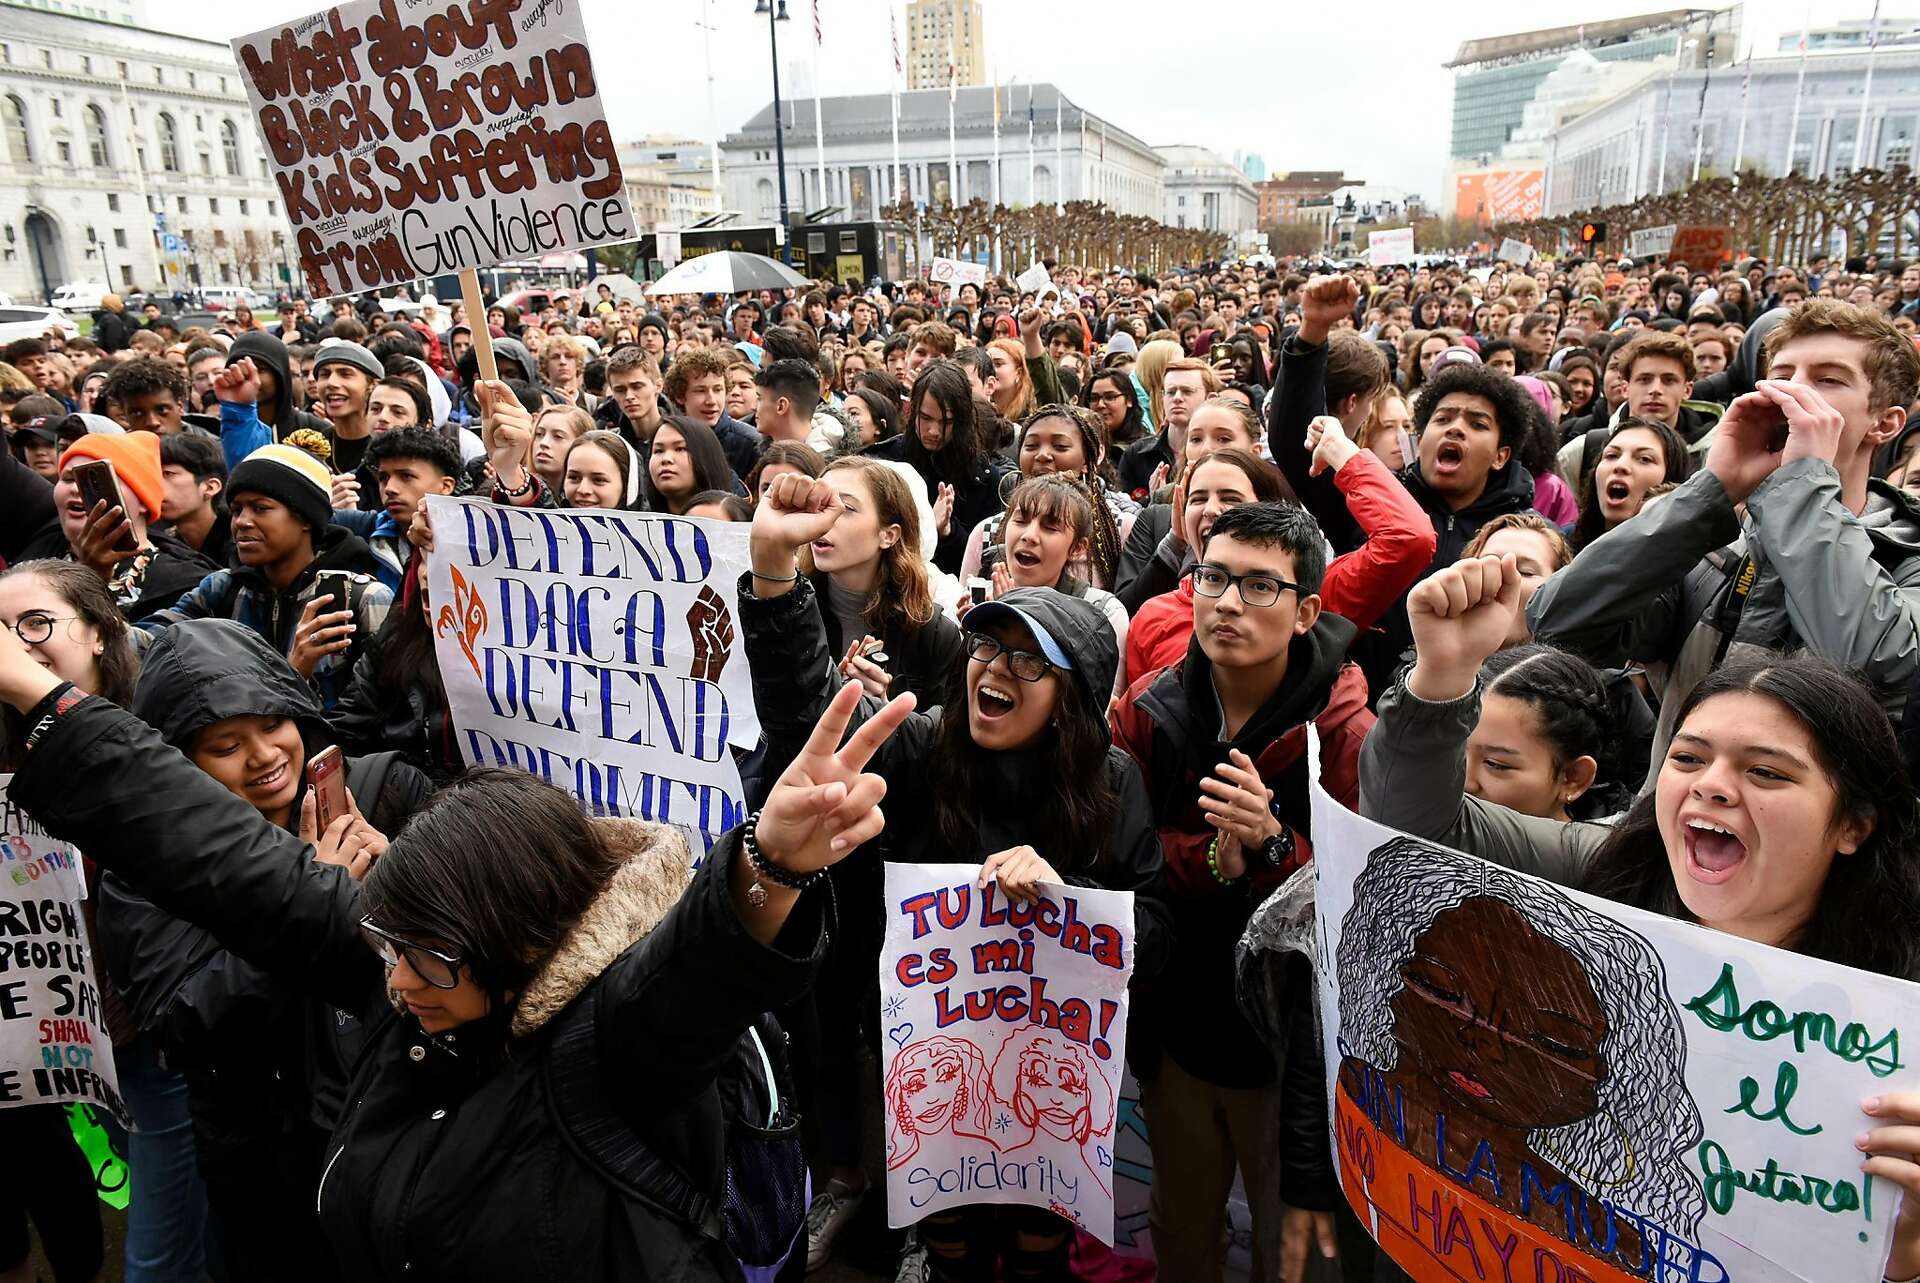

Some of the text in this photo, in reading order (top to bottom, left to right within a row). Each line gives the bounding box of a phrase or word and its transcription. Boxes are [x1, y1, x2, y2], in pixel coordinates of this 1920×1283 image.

[240, 0, 523, 100] What about
[383, 71, 430, 142] &
[402, 208, 481, 277] Gun
[466, 198, 628, 259] Violence
[459, 503, 713, 584] DEFEND
[495, 577, 668, 668] DACA
[482, 647, 730, 764] DEFEND
[464, 728, 749, 870] DAMER
[900, 883, 971, 940] TU
[895, 928, 1035, 988] es mi
[39, 1018, 92, 1044] SHALL
[41, 1045, 94, 1070] NOT
[934, 976, 1119, 1060] Lucha!
[1681, 962, 1905, 1078] Somos
[1723, 1061, 1824, 1136] el
[907, 1151, 1078, 1208] Solidarity
[1436, 1111, 1505, 1200] LA
[1408, 1172, 1518, 1283] HAY
